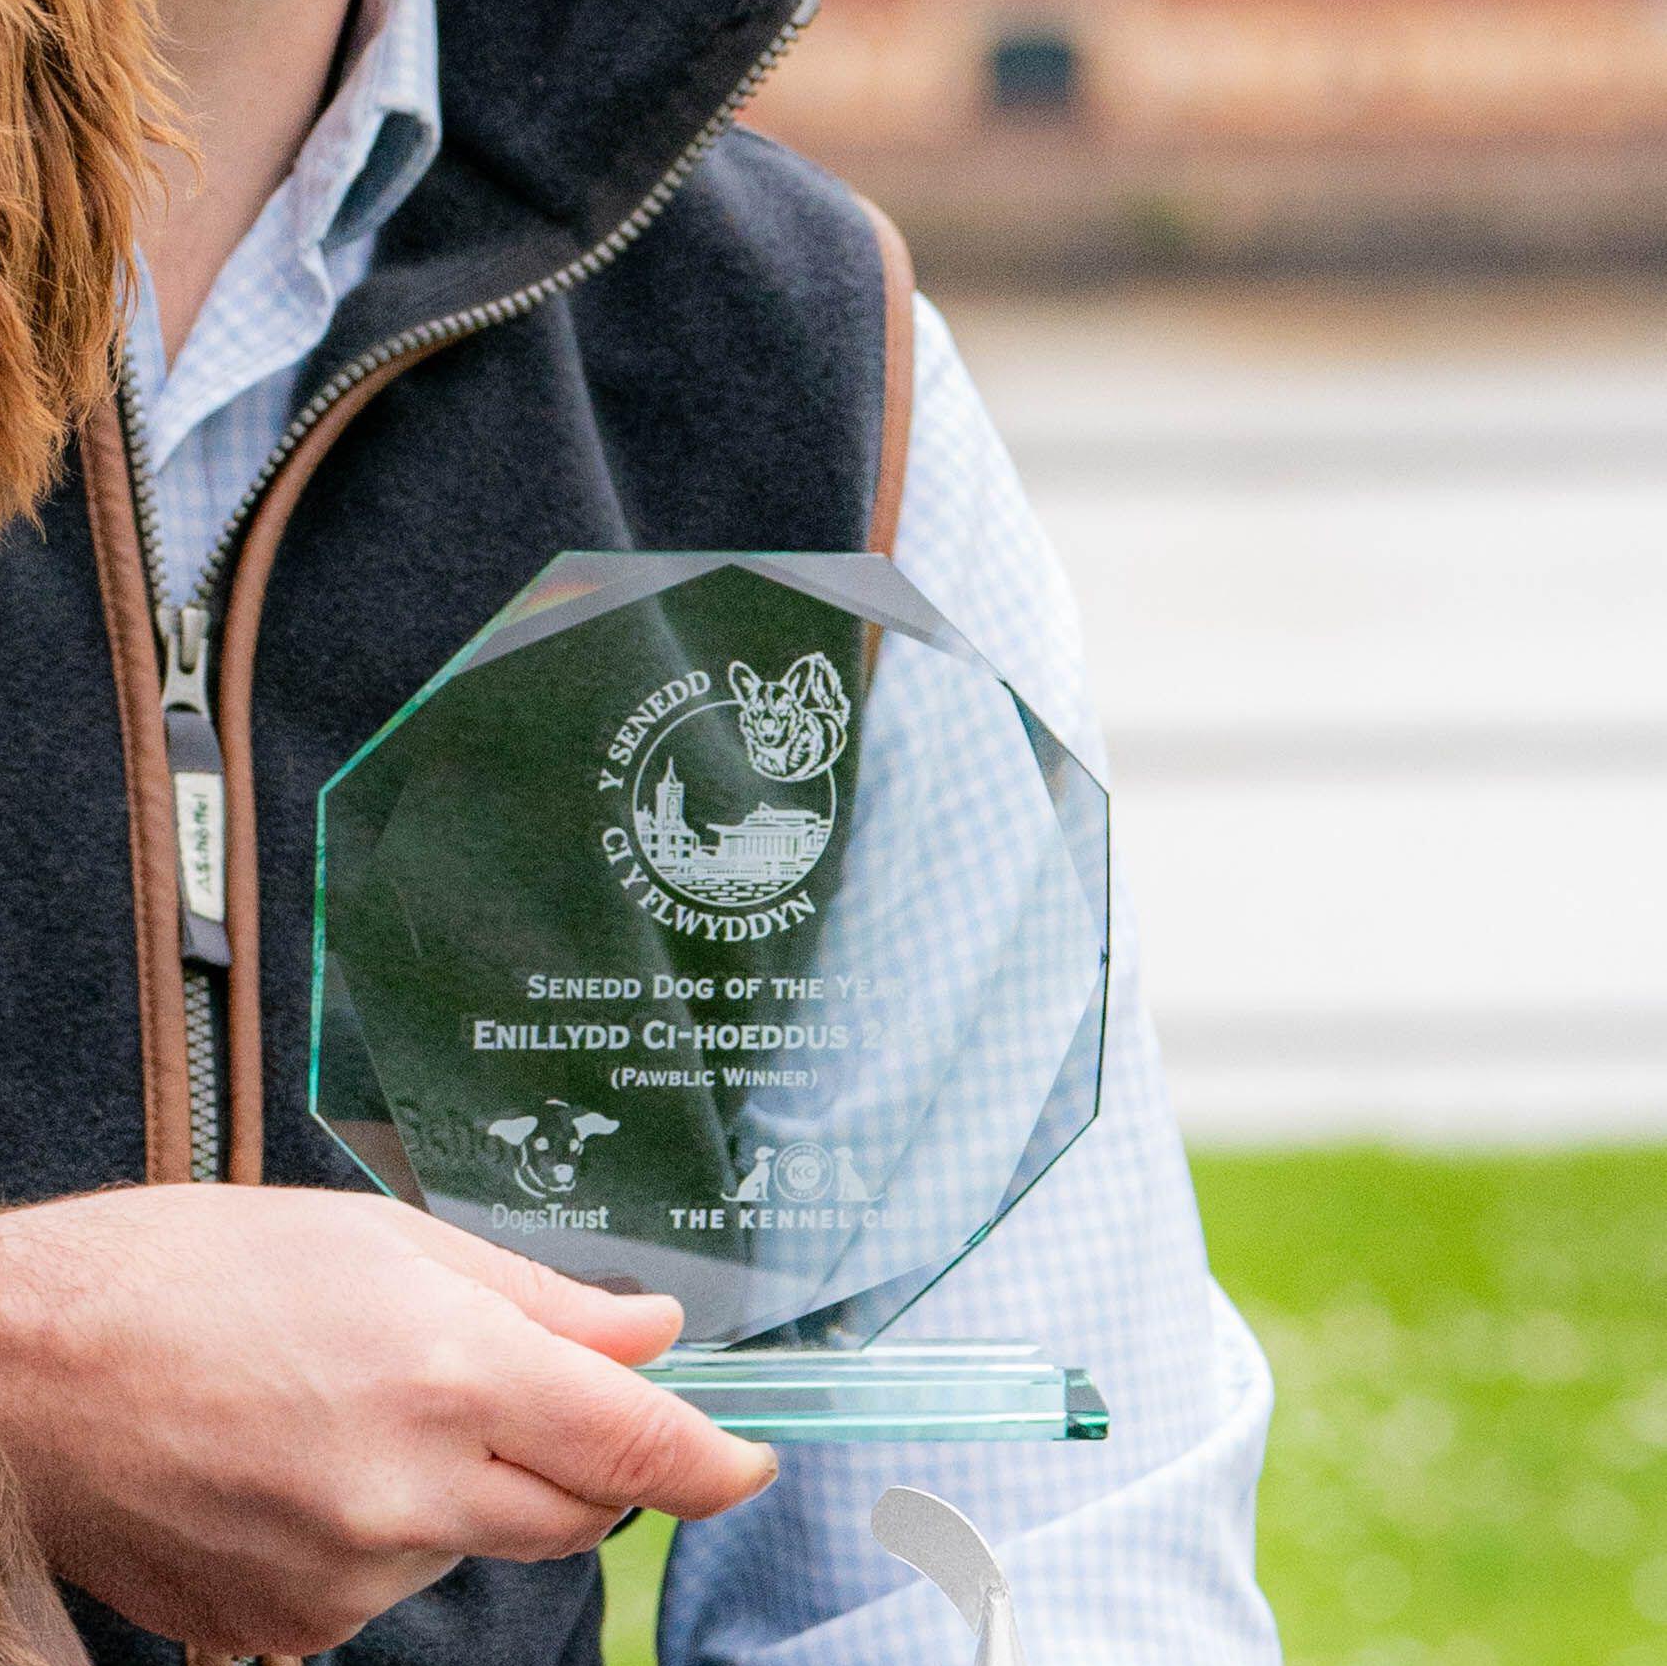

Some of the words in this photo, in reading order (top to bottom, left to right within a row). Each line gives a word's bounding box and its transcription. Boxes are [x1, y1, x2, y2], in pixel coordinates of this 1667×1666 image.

[608, 670, 711, 766] SENEDD
[598, 769, 624, 791] Y
[602, 827, 633, 865] CI
[620, 862, 649, 890] Y
[637, 886, 816, 942] FLWYDDYN
[792, 1166, 816, 1180] KC
[492, 1203, 609, 1234] DogsTrust
[668, 1208, 725, 1229] THE
[739, 1208, 850, 1229] KENNEL
